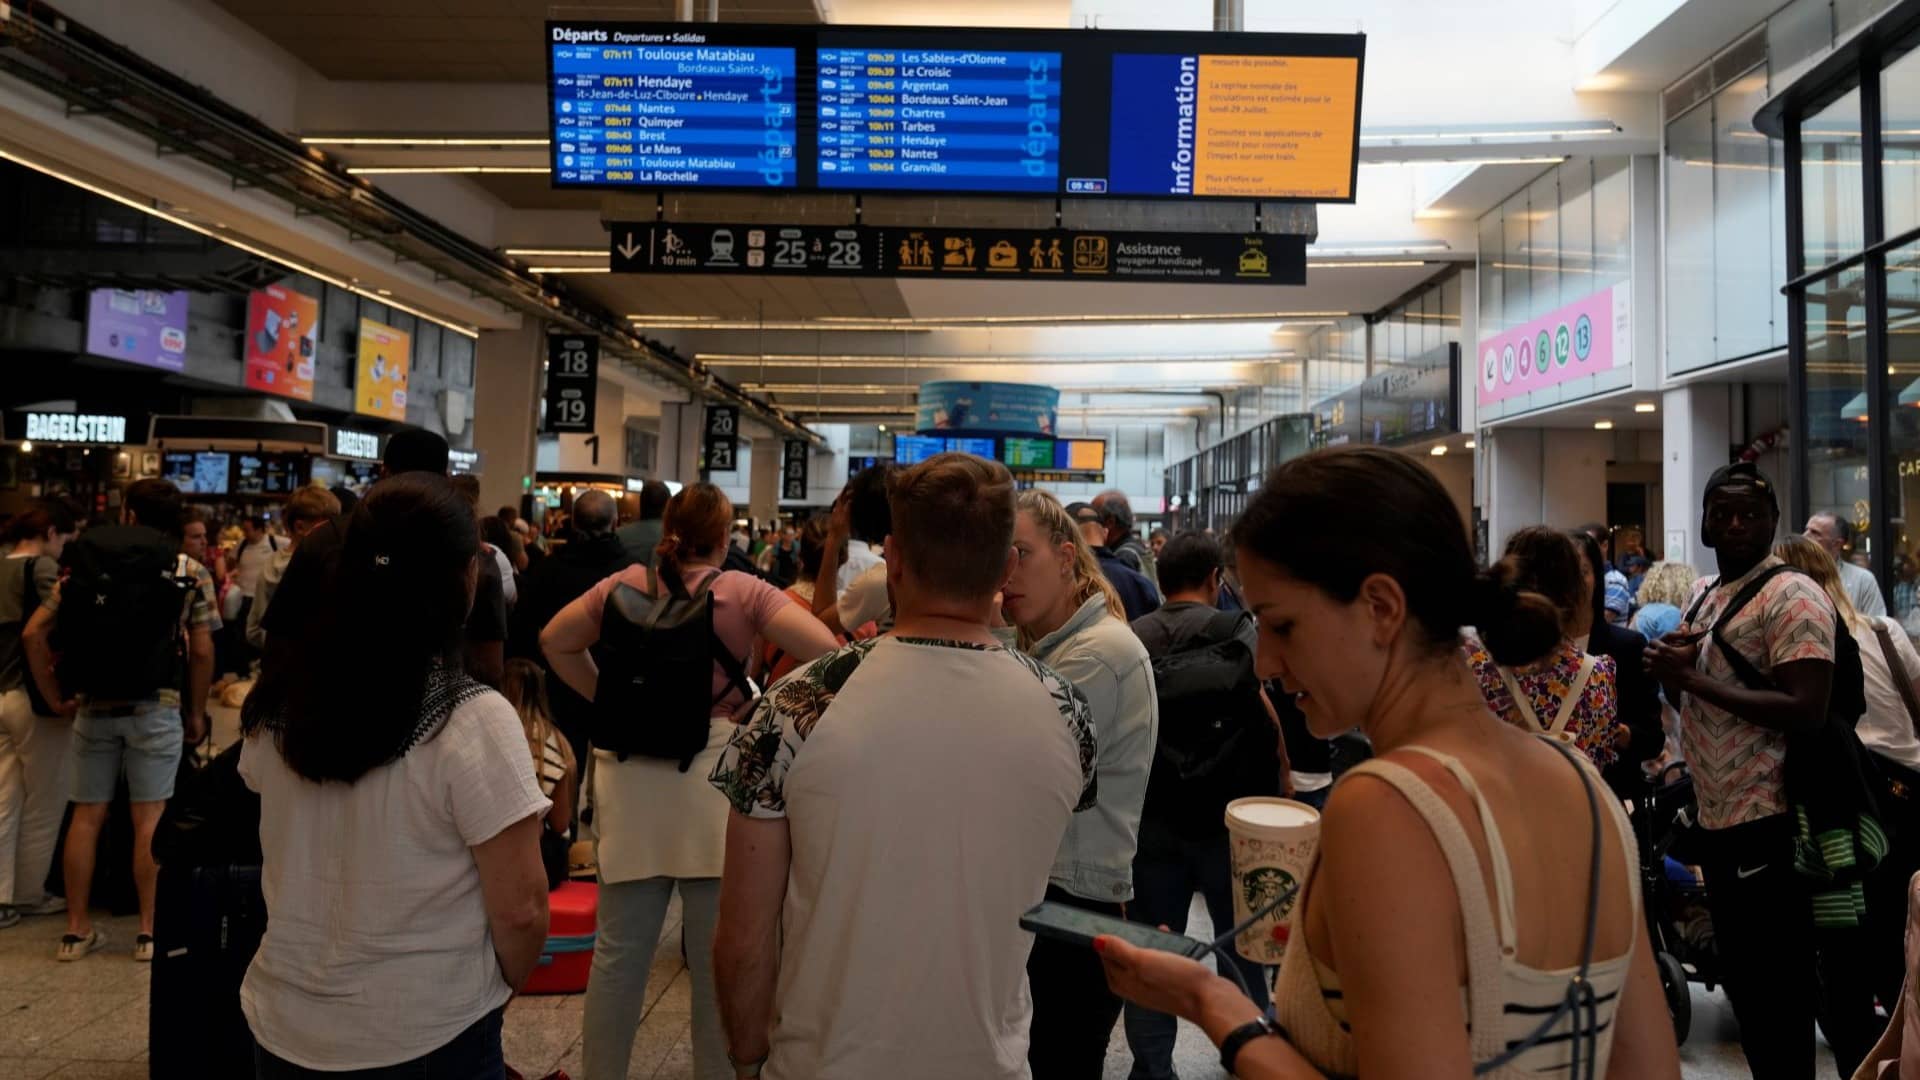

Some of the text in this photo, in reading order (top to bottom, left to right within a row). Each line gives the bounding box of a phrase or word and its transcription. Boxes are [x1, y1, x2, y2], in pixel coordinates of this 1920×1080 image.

[553, 27, 705, 44] Départs Departures Salidas
[603, 50, 633, 60] 07h11
[637, 49, 694, 61] Toulouse
[696, 49, 755, 62] Matabiau
[902, 53, 919, 64] Les
[922, 53, 1007, 65] Sables-d'Olonne
[678, 63, 726, 73] Bordeaux
[902, 67, 914, 77] Le
[917, 67, 951, 78] Croisic
[604, 77, 633, 87] 07h11
[638, 77, 692, 90] Hendaye
[902, 81, 949, 93] Argentan
[1209, 80, 1219, 89] La
[1221, 81, 1248, 91] reprise
[1284, 82, 1297, 91] des
[704, 91, 749, 103] Hendaye
[902, 94, 950, 105] Bordeaux
[952, 95, 1008, 106] Saint-Jean
[1209, 93, 1255, 102] circulations
[1303, 96, 1322, 104] pour
[638, 104, 675, 114] Nantes
[901, 108, 945, 119] Chartres
[1208, 104, 1229, 113] lundi
[1021, 57, 1052, 176] départs
[639, 117, 684, 129] Quimper
[758, 67, 783, 186] départs
[902, 122, 936, 132] Tarbes
[1171, 56, 1196, 194] information
[639, 130, 666, 141] Brest
[1207, 128, 1246, 137] Consultez
[1263, 129, 1311, 139] applications
[1312, 130, 1323, 138] de
[902, 135, 947, 147] Hendaye
[640, 145, 652, 154] Le
[654, 145, 681, 155] Mans
[902, 149, 938, 159] Nantes
[640, 158, 686, 168] Toulouse
[688, 159, 736, 170] Matabiau
[901, 162, 947, 173] Granville
[640, 171, 652, 181] La
[654, 171, 699, 182] Rochelle
[773, 238, 862, 265] 25 à 28
[1116, 242, 1182, 256] Assistance
[661, 255, 697, 266] 10 min
[1116, 255, 1203, 268] voyageur handicapé
[1504, 354, 1512, 375] M
[1539, 342, 1546, 363] 6
[1557, 330, 1568, 356] 12
[1577, 325, 1589, 350] 13
[559, 350, 589, 373] 18
[556, 399, 586, 422] 19
[26, 412, 126, 443] BAGELSTEIN
[712, 416, 733, 433] 20
[337, 429, 378, 459] BAGELSTEIN
[584, 435, 599, 465] 1
[711, 449, 732, 465] 21
